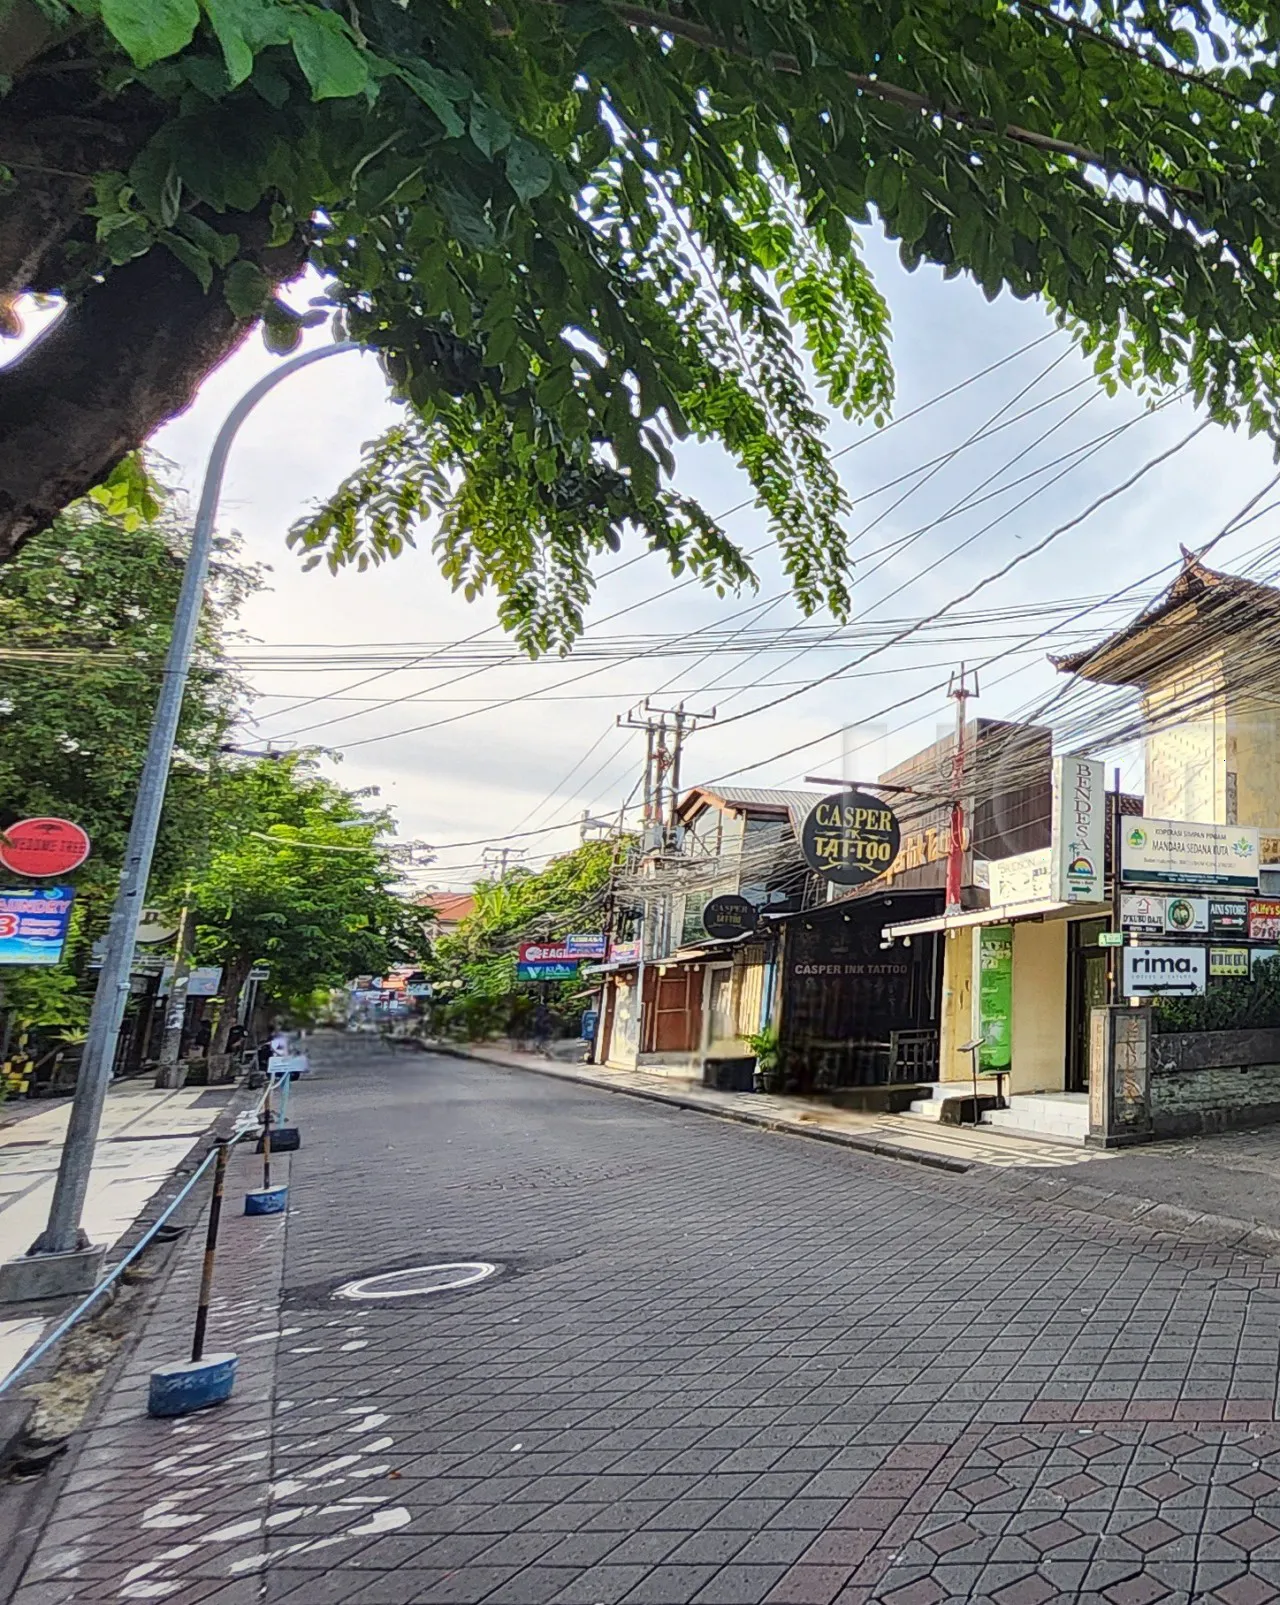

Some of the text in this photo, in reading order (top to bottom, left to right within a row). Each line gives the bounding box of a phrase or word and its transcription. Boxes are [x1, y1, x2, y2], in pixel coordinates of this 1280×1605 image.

[1073, 762, 1092, 852] BENDESA
[814, 803, 893, 832] CASPER
[1152, 840, 1186, 853] MANDARA
[1186, 842, 1212, 855] SEDANA
[1224, 904, 1247, 916] STORE
[1256, 904, 1275, 915] Life's
[1132, 949, 1198, 974] rima.
[794, 964, 908, 975] CASPER INK TATTOO
